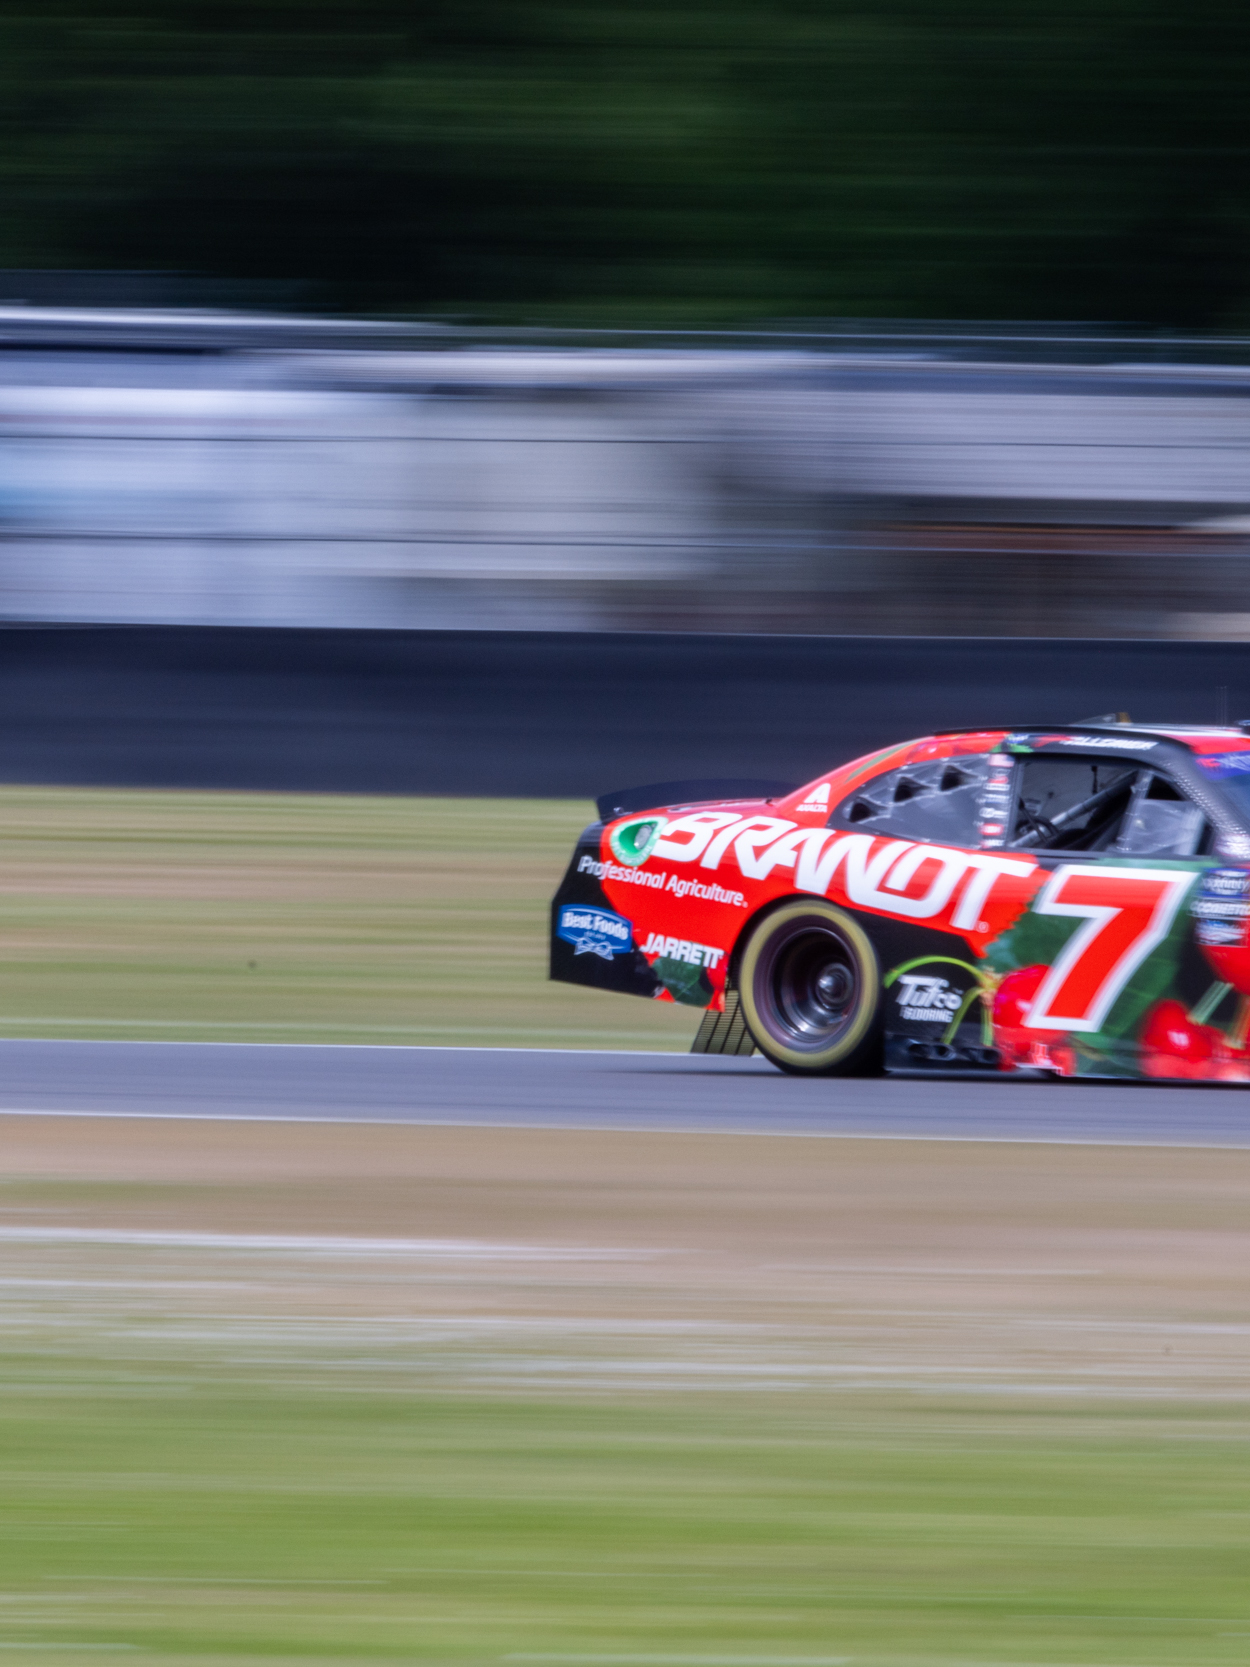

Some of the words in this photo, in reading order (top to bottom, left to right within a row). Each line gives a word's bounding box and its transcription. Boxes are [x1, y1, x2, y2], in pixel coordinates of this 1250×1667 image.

[577, 855, 666, 890] Professional
[650, 812, 1040, 931] BRANDT
[561, 911, 593, 930] Best
[592, 914, 629, 940] Foods
[639, 932, 725, 970] JARRETT
[1020, 864, 1201, 1033] 7
